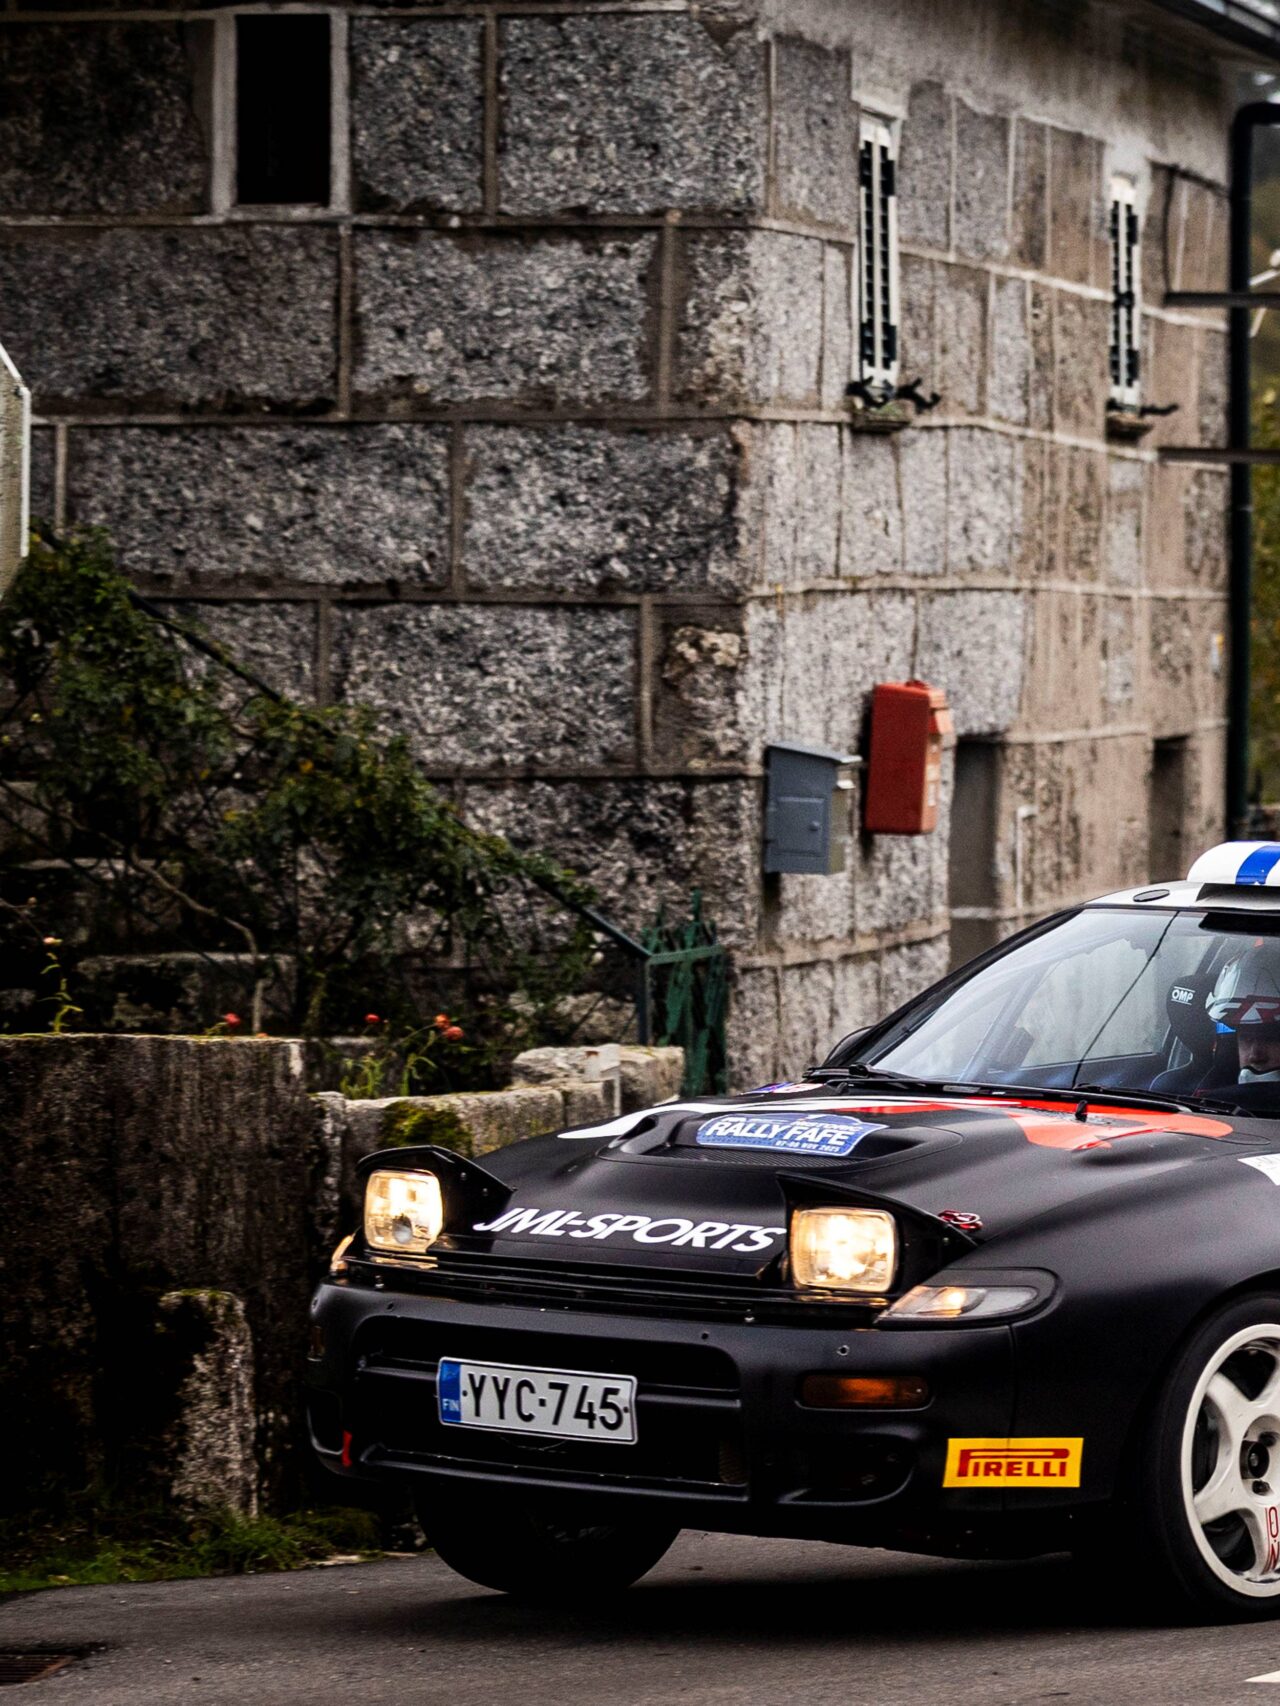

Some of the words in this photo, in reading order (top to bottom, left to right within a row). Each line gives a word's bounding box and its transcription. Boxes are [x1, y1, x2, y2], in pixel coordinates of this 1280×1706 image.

[1172, 989, 1194, 1002] OMP
[705, 1121, 784, 1139] RALLY
[784, 1125, 854, 1145] FAFE
[472, 1207, 787, 1252] JML-SPORTS
[957, 1448, 1071, 1477] PIRELLI
